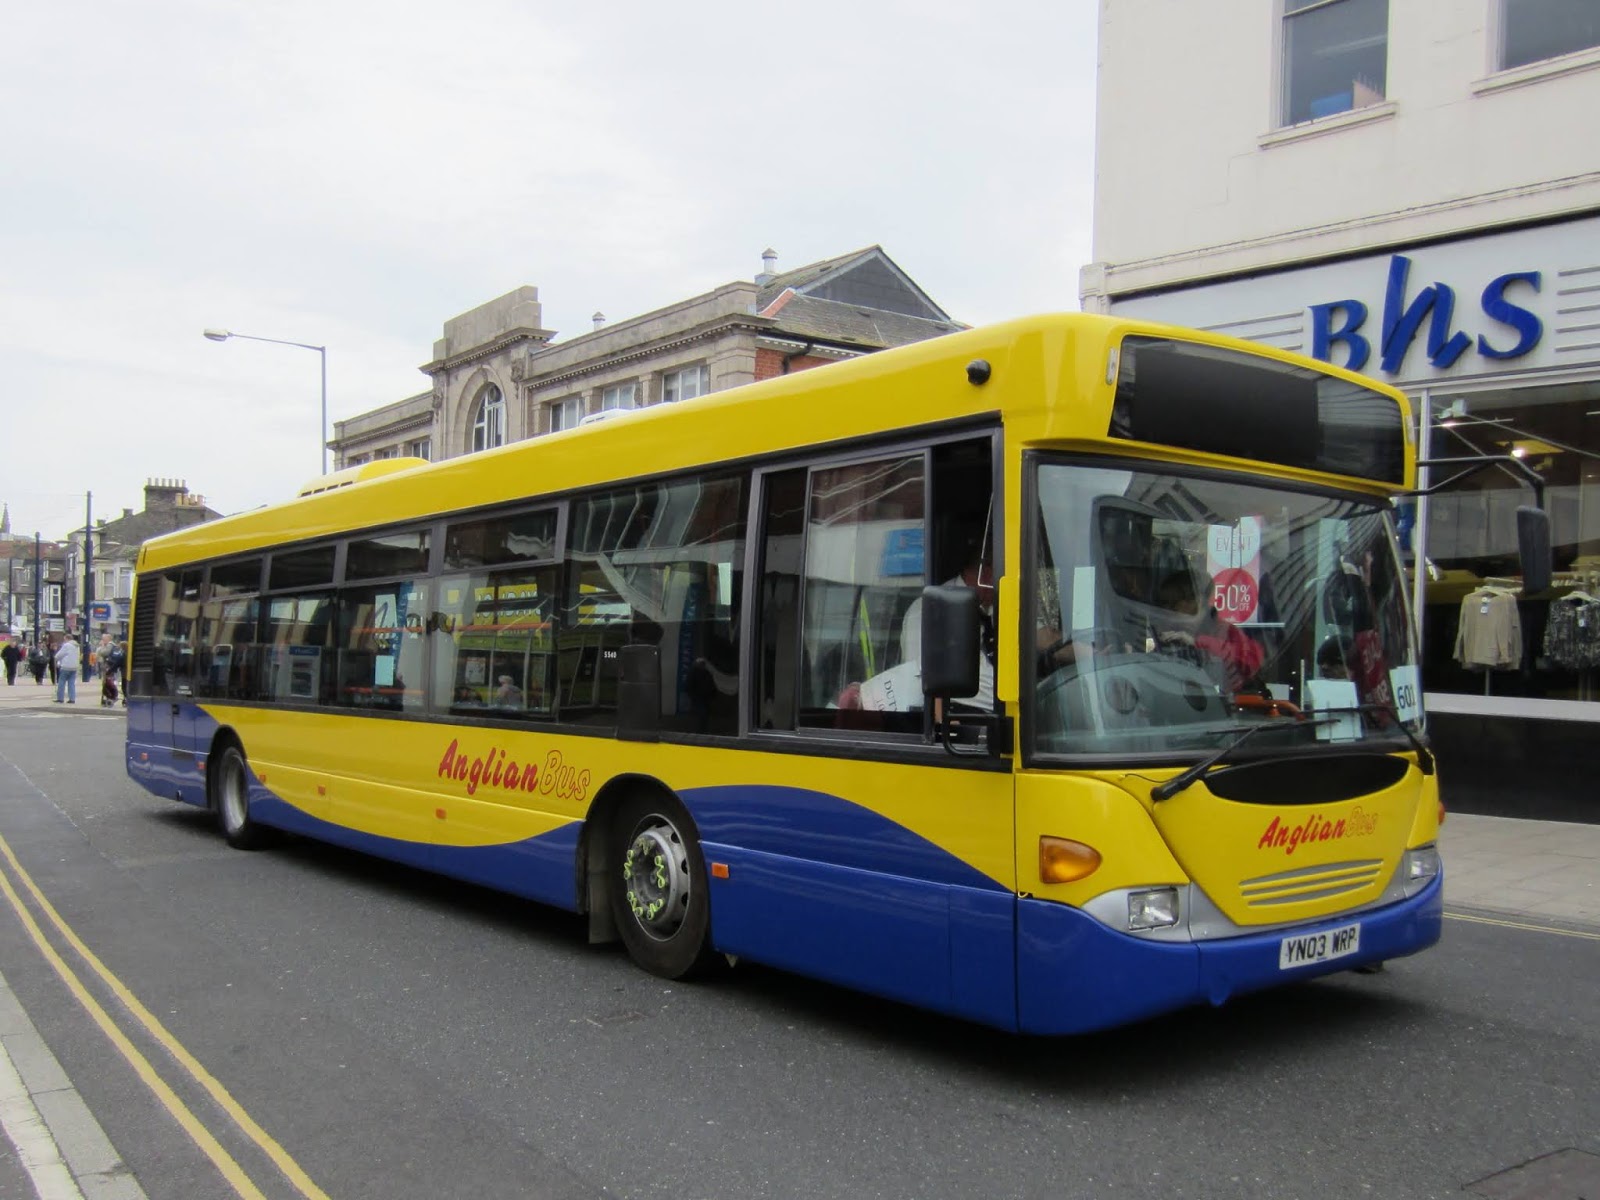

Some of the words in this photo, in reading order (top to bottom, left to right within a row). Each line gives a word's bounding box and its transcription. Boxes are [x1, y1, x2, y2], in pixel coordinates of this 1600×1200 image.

[1240, 602, 1251, 611] OFF
[1397, 684, 1416, 710] 601
[1287, 935, 1327, 963] YN03
[1332, 927, 1356, 953] WRP
